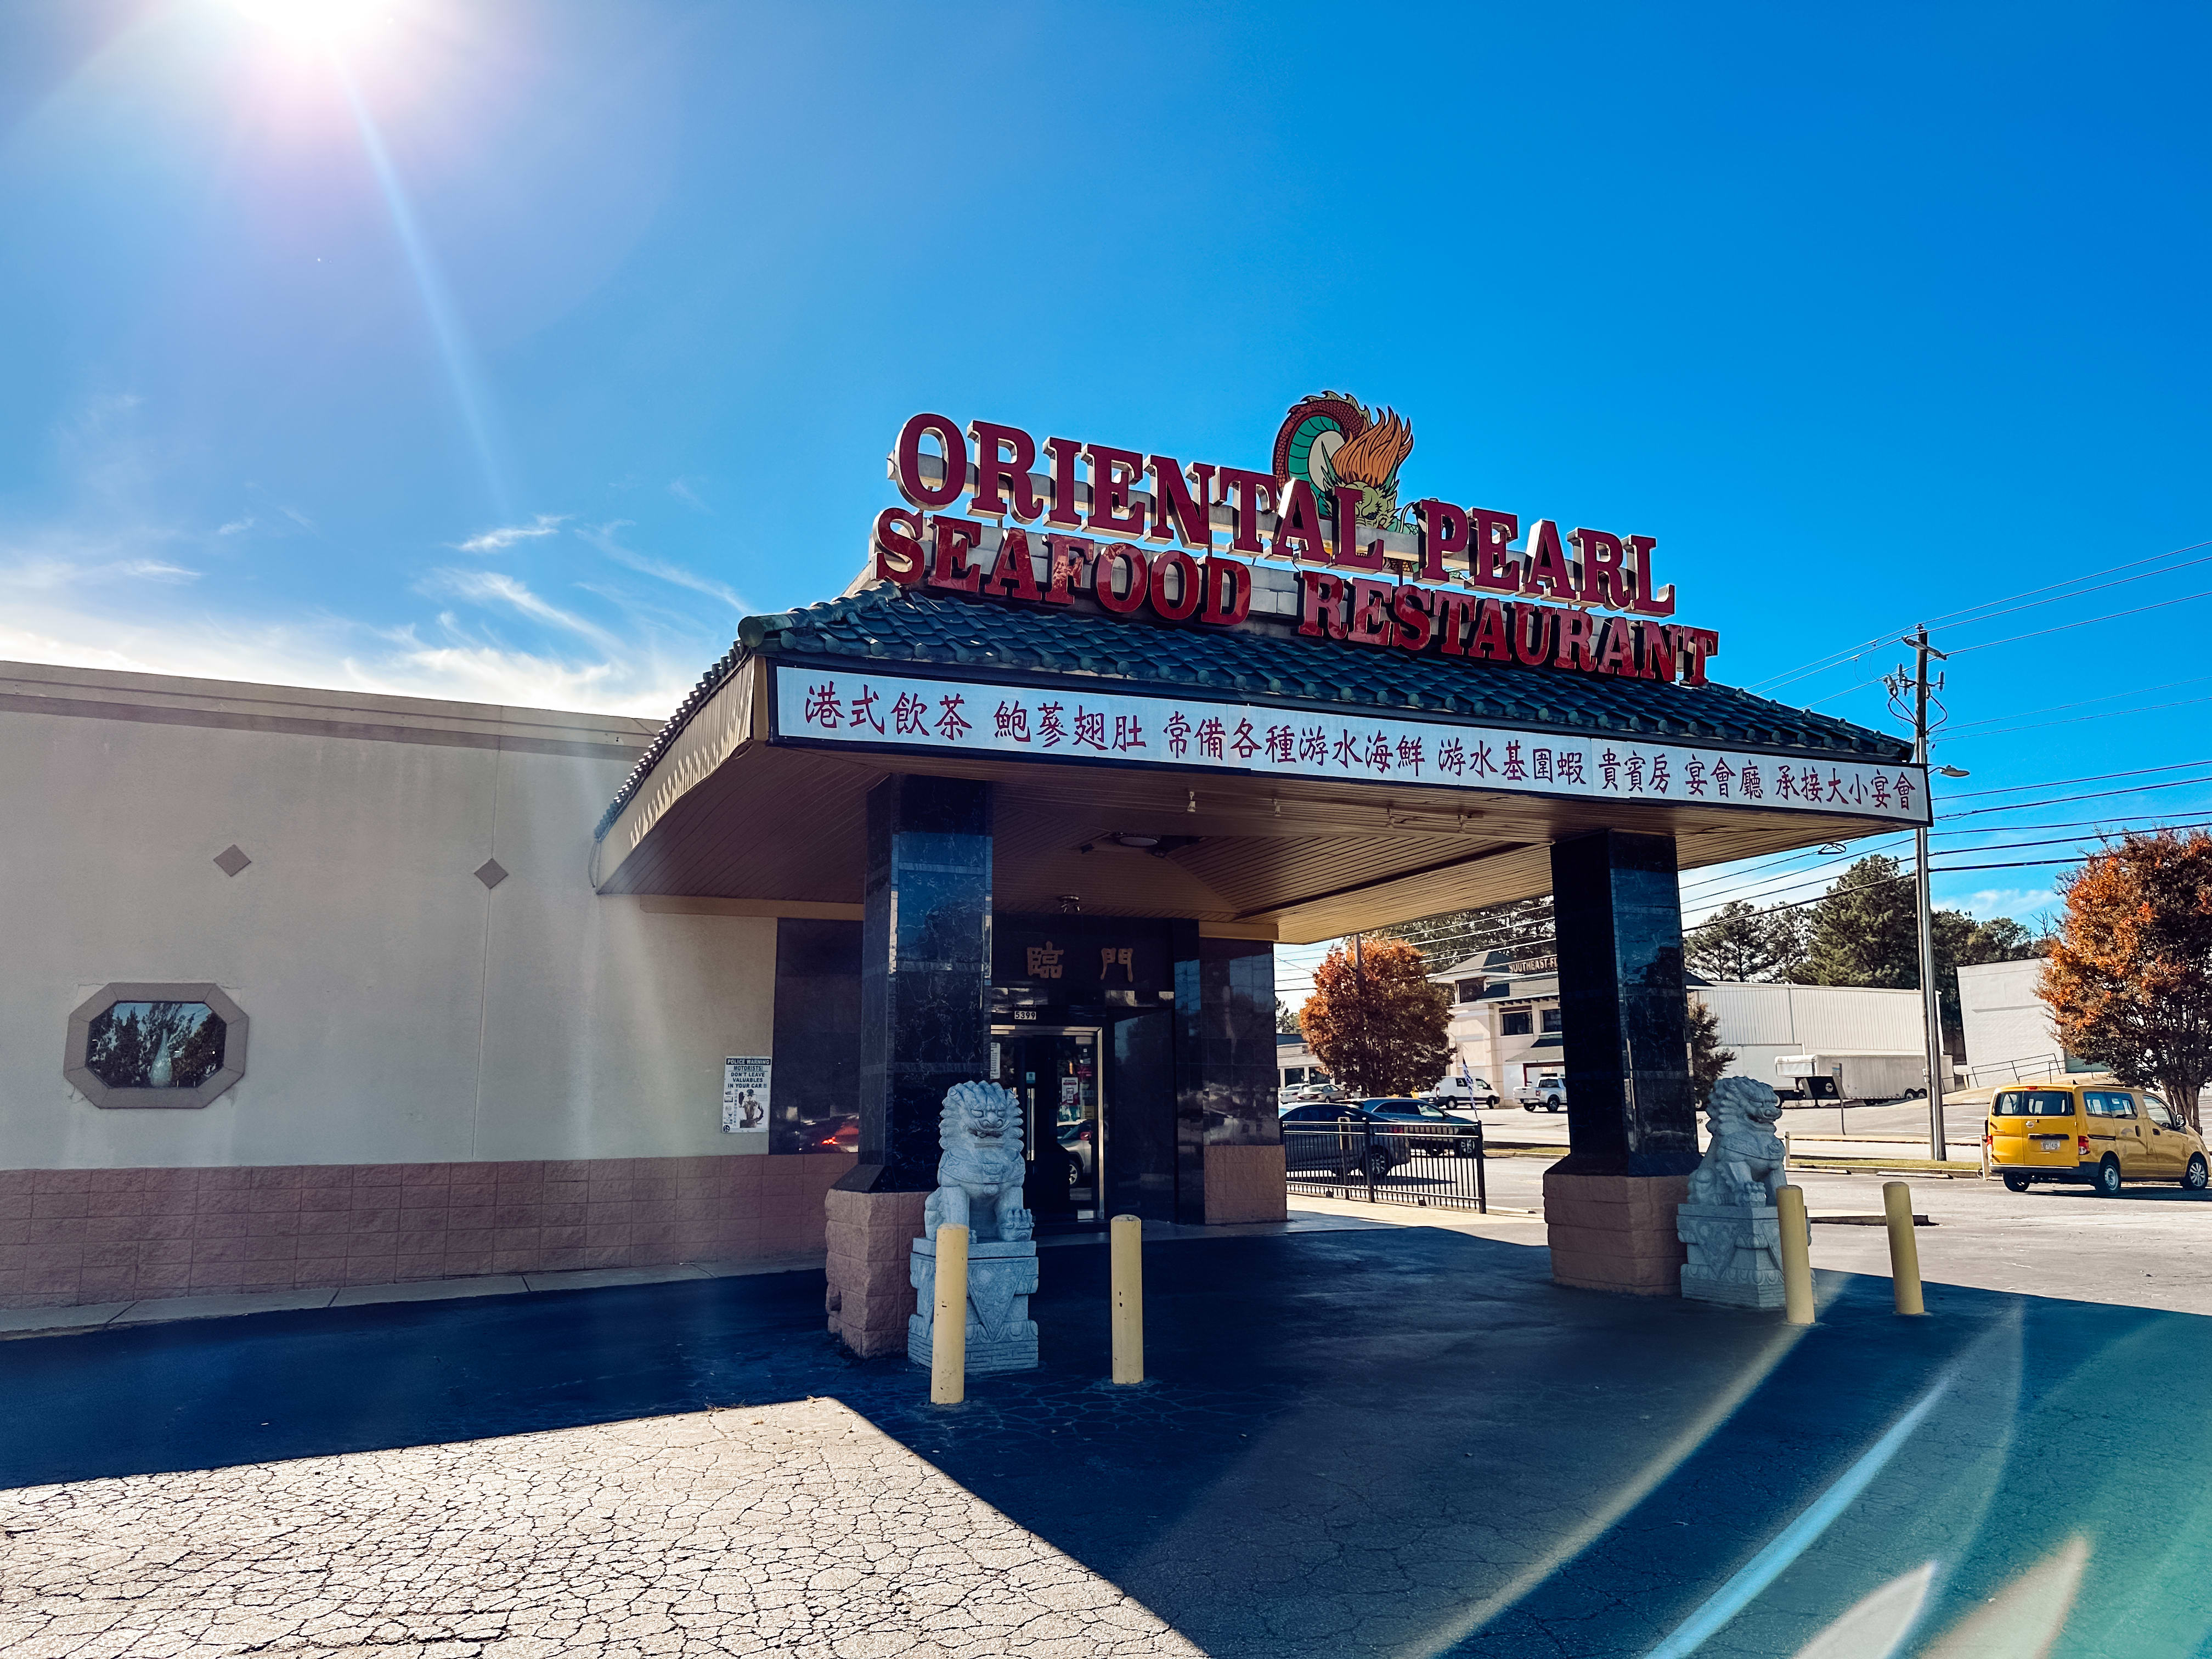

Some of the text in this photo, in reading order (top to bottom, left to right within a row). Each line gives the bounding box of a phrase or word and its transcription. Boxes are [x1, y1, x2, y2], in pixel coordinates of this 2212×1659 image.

[896, 413, 1675, 617] ORIENTAL PEARL
[873, 507, 1719, 687] SEAFOOD RESTAURANT
[805, 680, 973, 741] 港式飲茶
[1163, 710, 1425, 777] 常備各種游水海鮮
[1438, 737, 1587, 785] 游水基圍蝦
[1598, 747, 1671, 794] 貴賓房
[1684, 753, 1764, 800] 宴會廳
[1775, 765, 1916, 811] 承接大小宴會
[1509, 959, 1548, 973] SOUTHEAST
